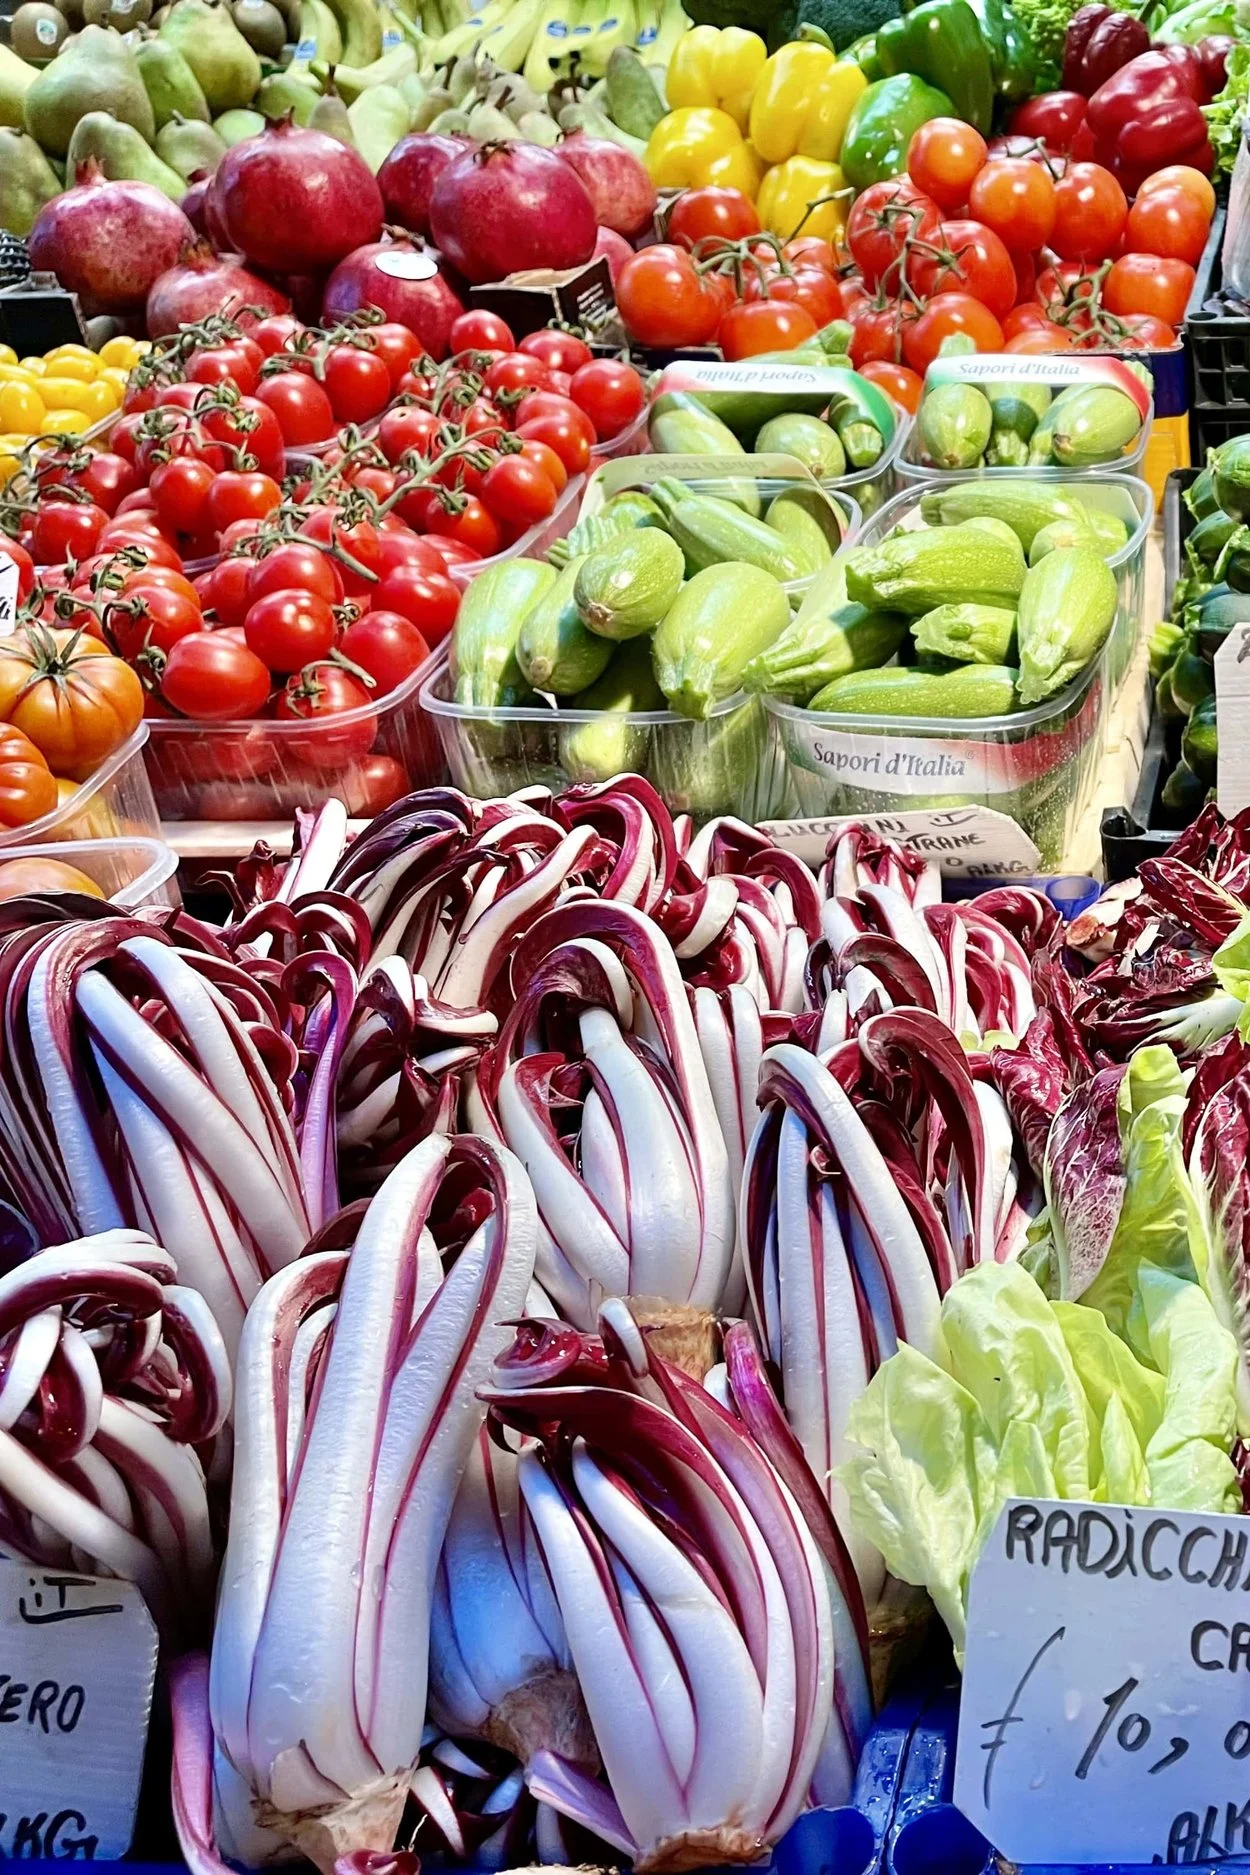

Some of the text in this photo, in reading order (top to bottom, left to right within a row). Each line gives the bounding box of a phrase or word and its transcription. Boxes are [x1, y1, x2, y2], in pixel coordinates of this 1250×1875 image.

[696, 370, 817, 383] Sapori d'Italia
[960, 363, 1080, 376] Sapori d'Italia
[814, 742, 965, 776] Sapori d'Italia
[0, 1810, 98, 1859] KG
